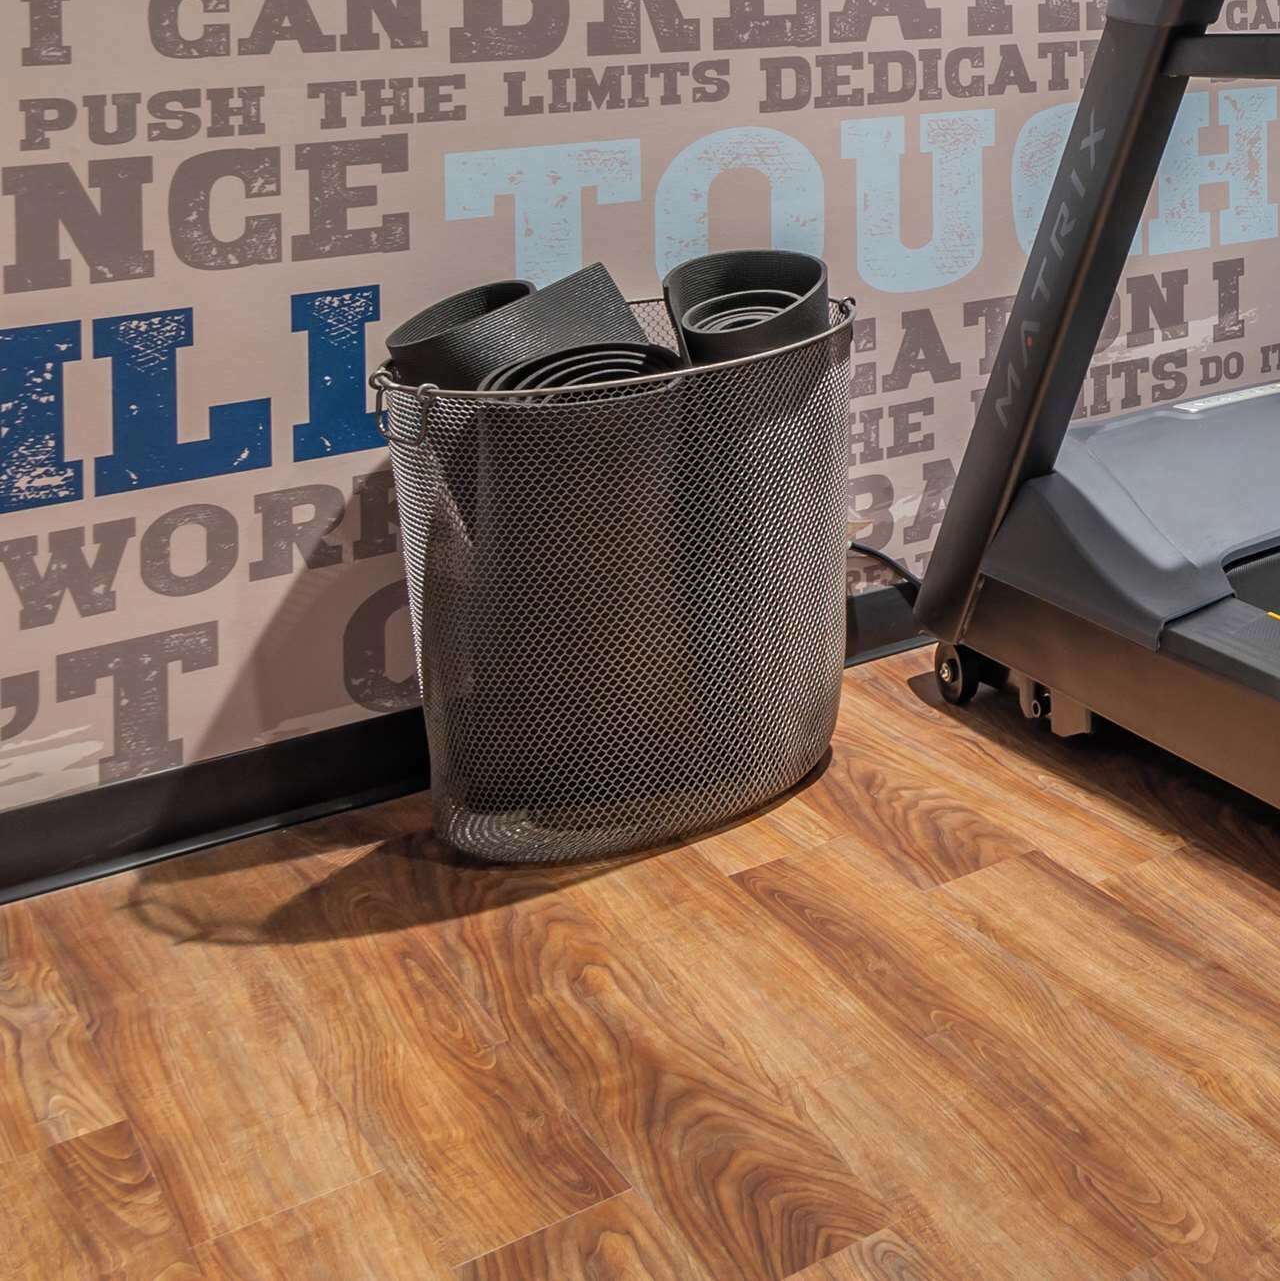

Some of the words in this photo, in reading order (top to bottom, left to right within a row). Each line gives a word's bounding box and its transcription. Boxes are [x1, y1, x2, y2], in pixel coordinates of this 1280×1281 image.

[19, 85, 266, 151] PUSH
[306, 74, 467, 130] THE
[503, 58, 731, 117] LIMITS
[759, 41, 1098, 114] DEDICAT
[994, 109, 1106, 431] MATRIX
[1212, 258, 1245, 343] I
[1200, 352, 1245, 385] DO
